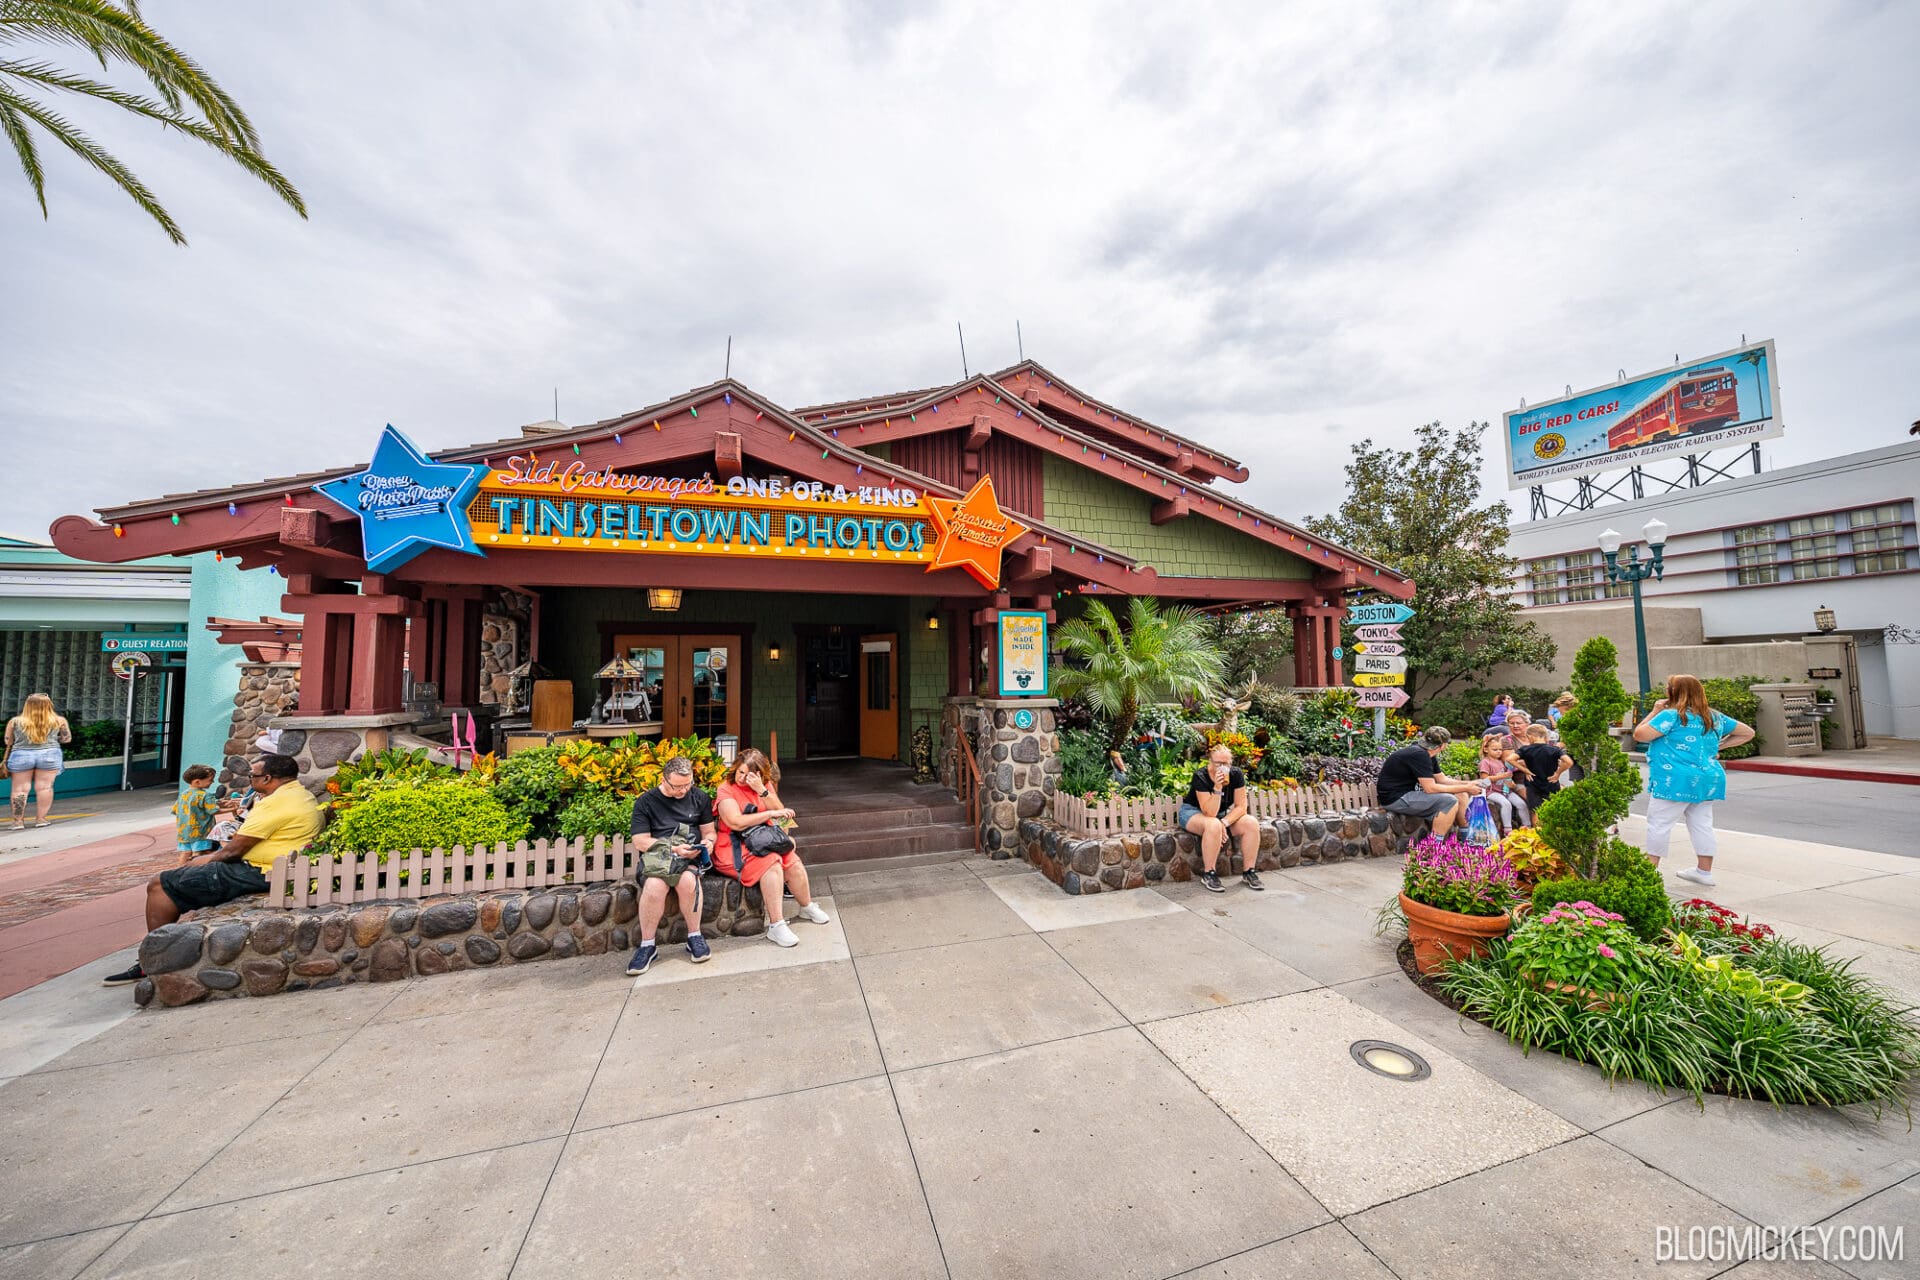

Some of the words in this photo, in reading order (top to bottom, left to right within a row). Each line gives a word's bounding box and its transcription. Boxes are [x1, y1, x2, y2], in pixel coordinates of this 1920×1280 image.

[1518, 421, 1542, 435] BIG
[1546, 414, 1573, 428] RED
[1577, 401, 1620, 421] CARS!
[1517, 469, 1550, 481] WORLD'S
[1551, 461, 1585, 474] LARGEST
[1585, 451, 1639, 467] INTERURBAN
[1640, 440, 1684, 456] ELECTRIC
[1685, 431, 1727, 446] RAILWAY
[1726, 424, 1765, 439] SYSTEM
[498, 455, 560, 485] Sid
[560, 460, 716, 499] Cahuenga's
[490, 496, 770, 546] TINSELTOWN
[785, 514, 925, 552] PHOTOS
[1358, 607, 1396, 620] BOSTON
[1361, 628, 1389, 638] TOKYO
[121, 640, 148, 648] GUEST
[1370, 645, 1396, 653] CHICAGO
[1365, 659, 1390, 670] PARIS
[1369, 676, 1395, 685] ORLANDO
[1365, 692, 1392, 701] ROME
